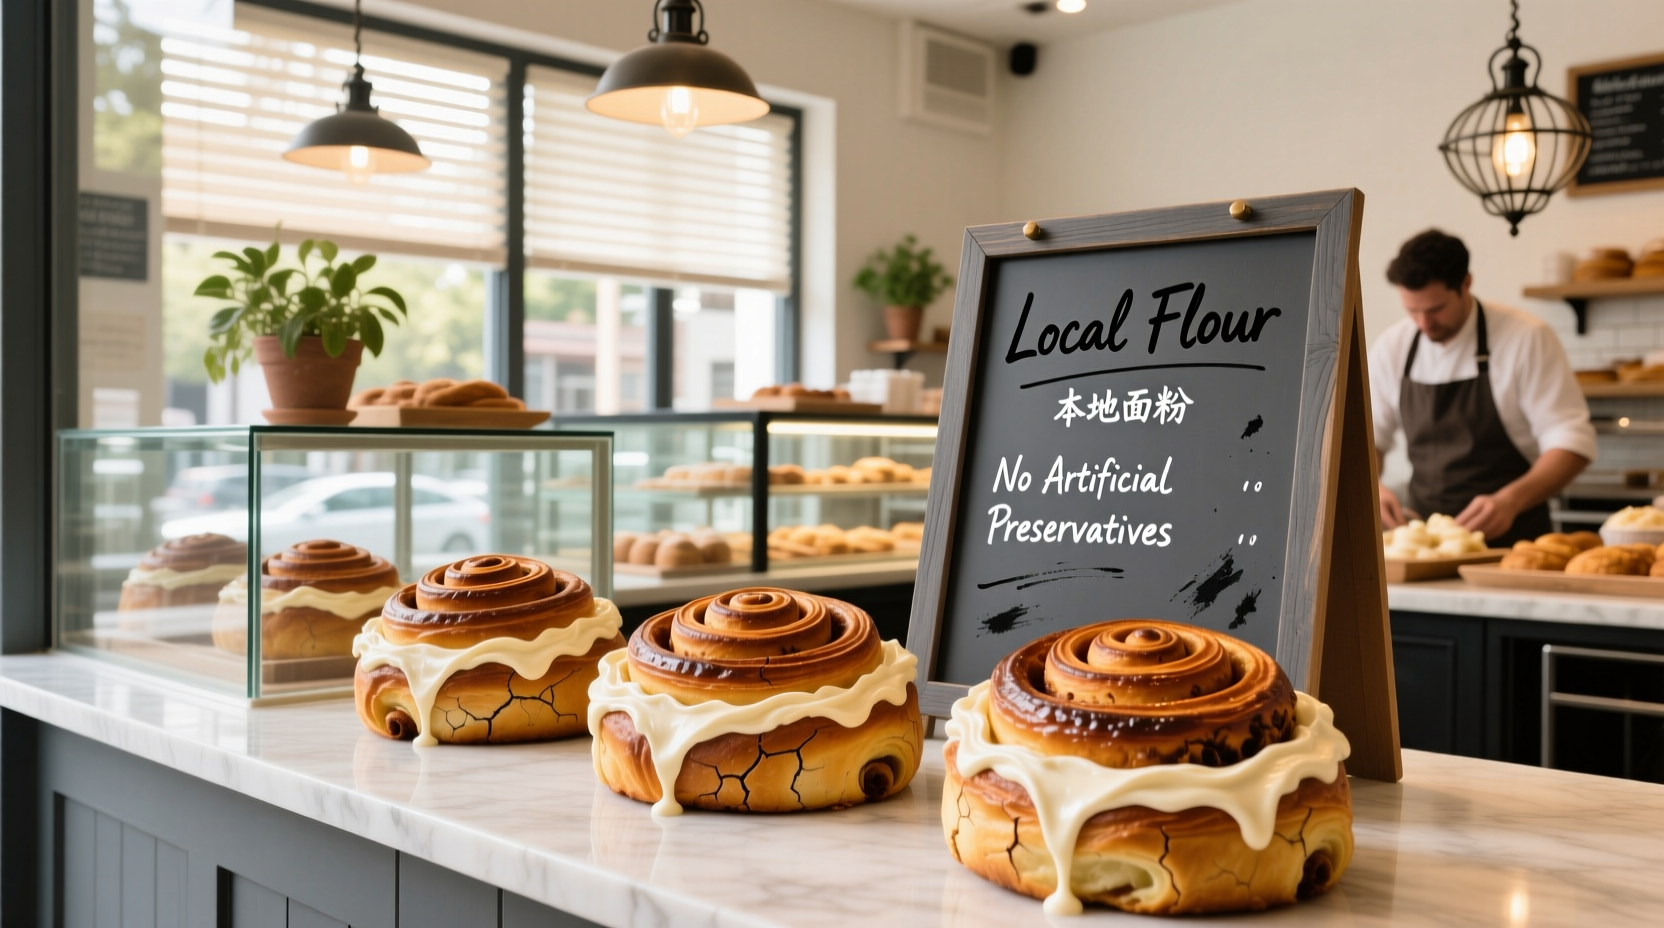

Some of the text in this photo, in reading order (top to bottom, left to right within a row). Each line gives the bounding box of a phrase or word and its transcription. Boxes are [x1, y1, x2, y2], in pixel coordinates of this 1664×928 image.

[1005, 281, 1282, 364] Local Flour
[1053, 386, 1195, 428] 本地面粉
[992, 453, 1173, 501] No Artificial
[987, 503, 1173, 548] Preservatives
